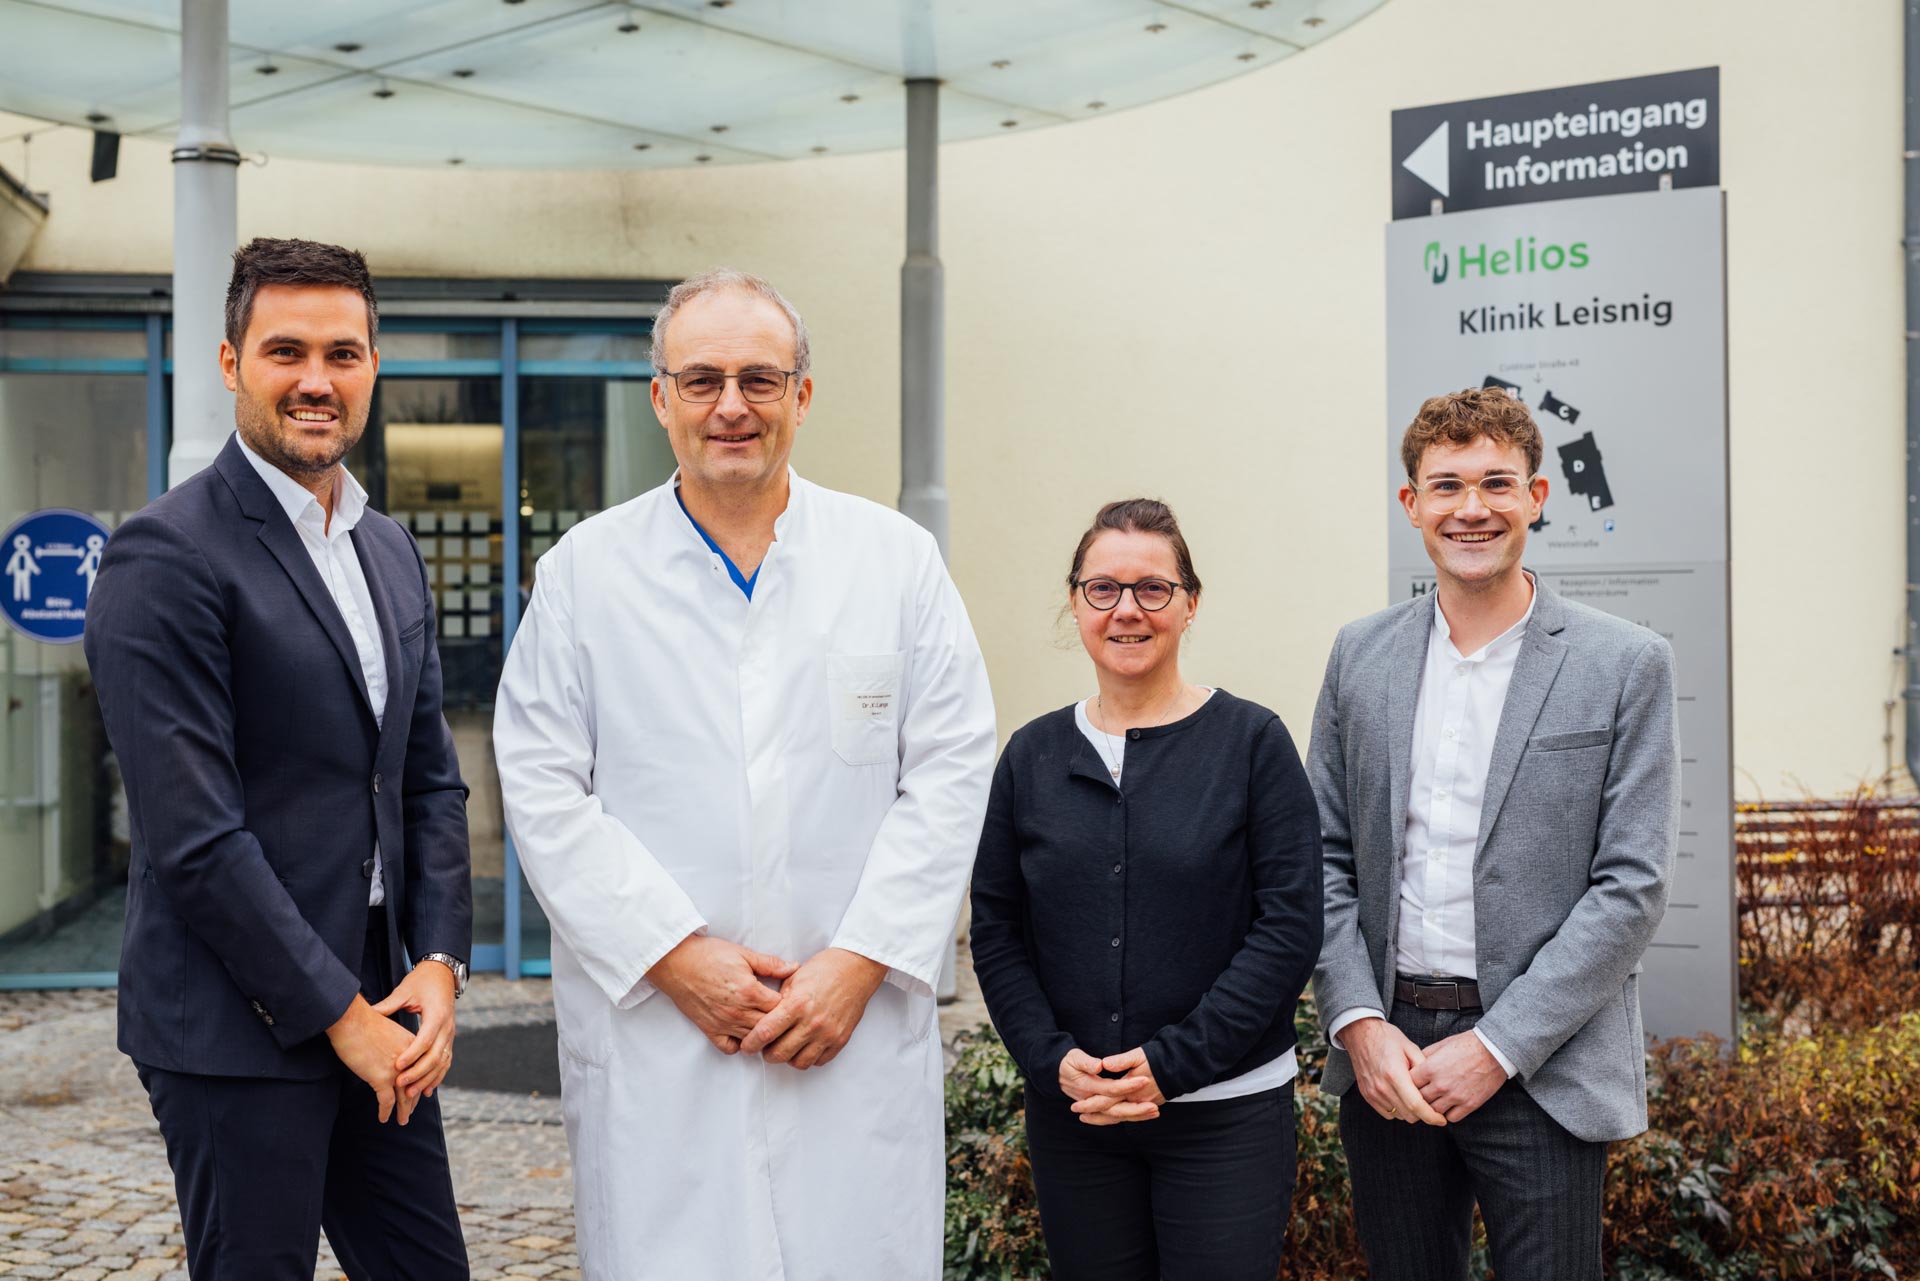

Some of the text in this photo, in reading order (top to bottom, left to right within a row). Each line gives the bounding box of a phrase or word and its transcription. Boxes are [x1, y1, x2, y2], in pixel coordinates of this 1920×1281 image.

[1466, 98, 1708, 149] Haupteingang
[1485, 142, 1689, 190] Information
[1459, 236, 1590, 279] Helios
[1460, 293, 1673, 335] Klinik Leisnig
[1559, 405, 1571, 418] C
[1573, 460, 1585, 473] D
